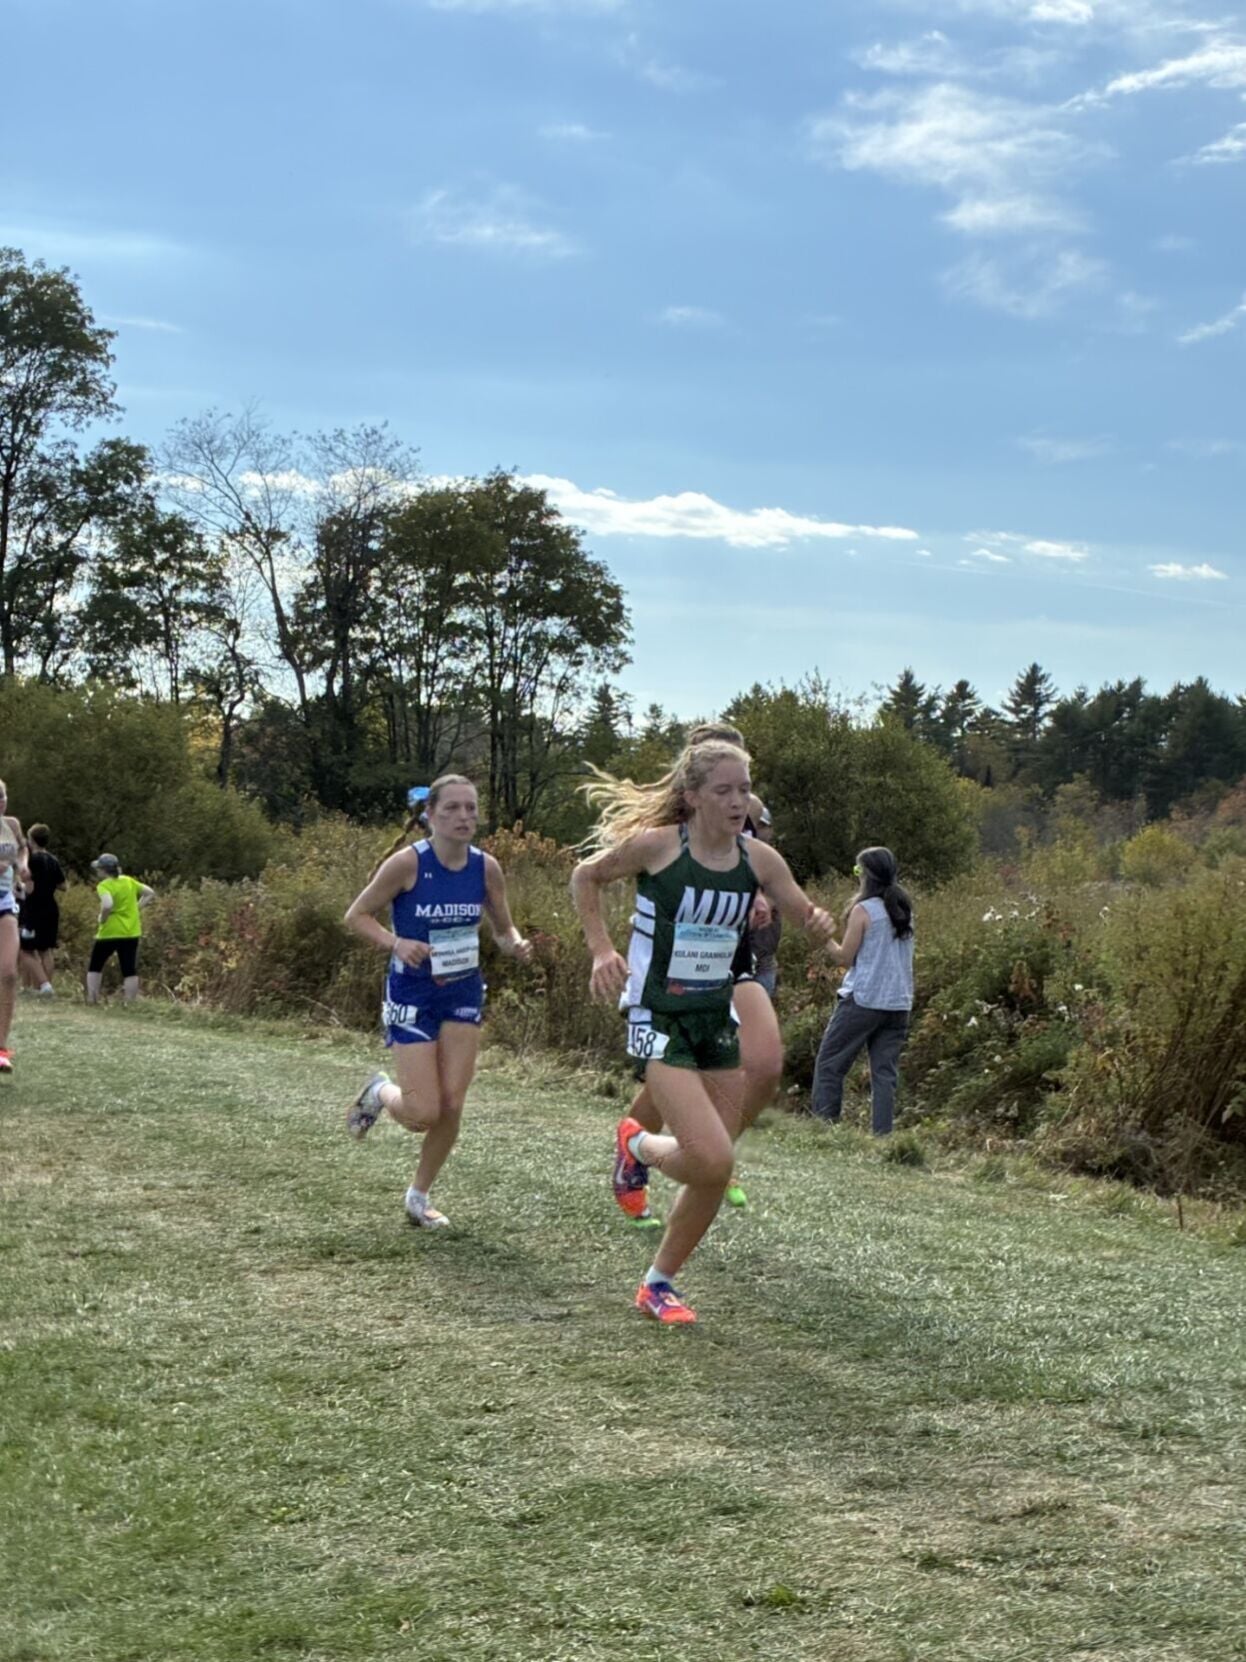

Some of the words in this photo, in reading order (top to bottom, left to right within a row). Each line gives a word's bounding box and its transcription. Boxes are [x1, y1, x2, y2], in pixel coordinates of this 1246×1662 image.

[415, 904, 482, 918] MADISON
[674, 885, 751, 930] MDI
[695, 964, 710, 973] MDI
